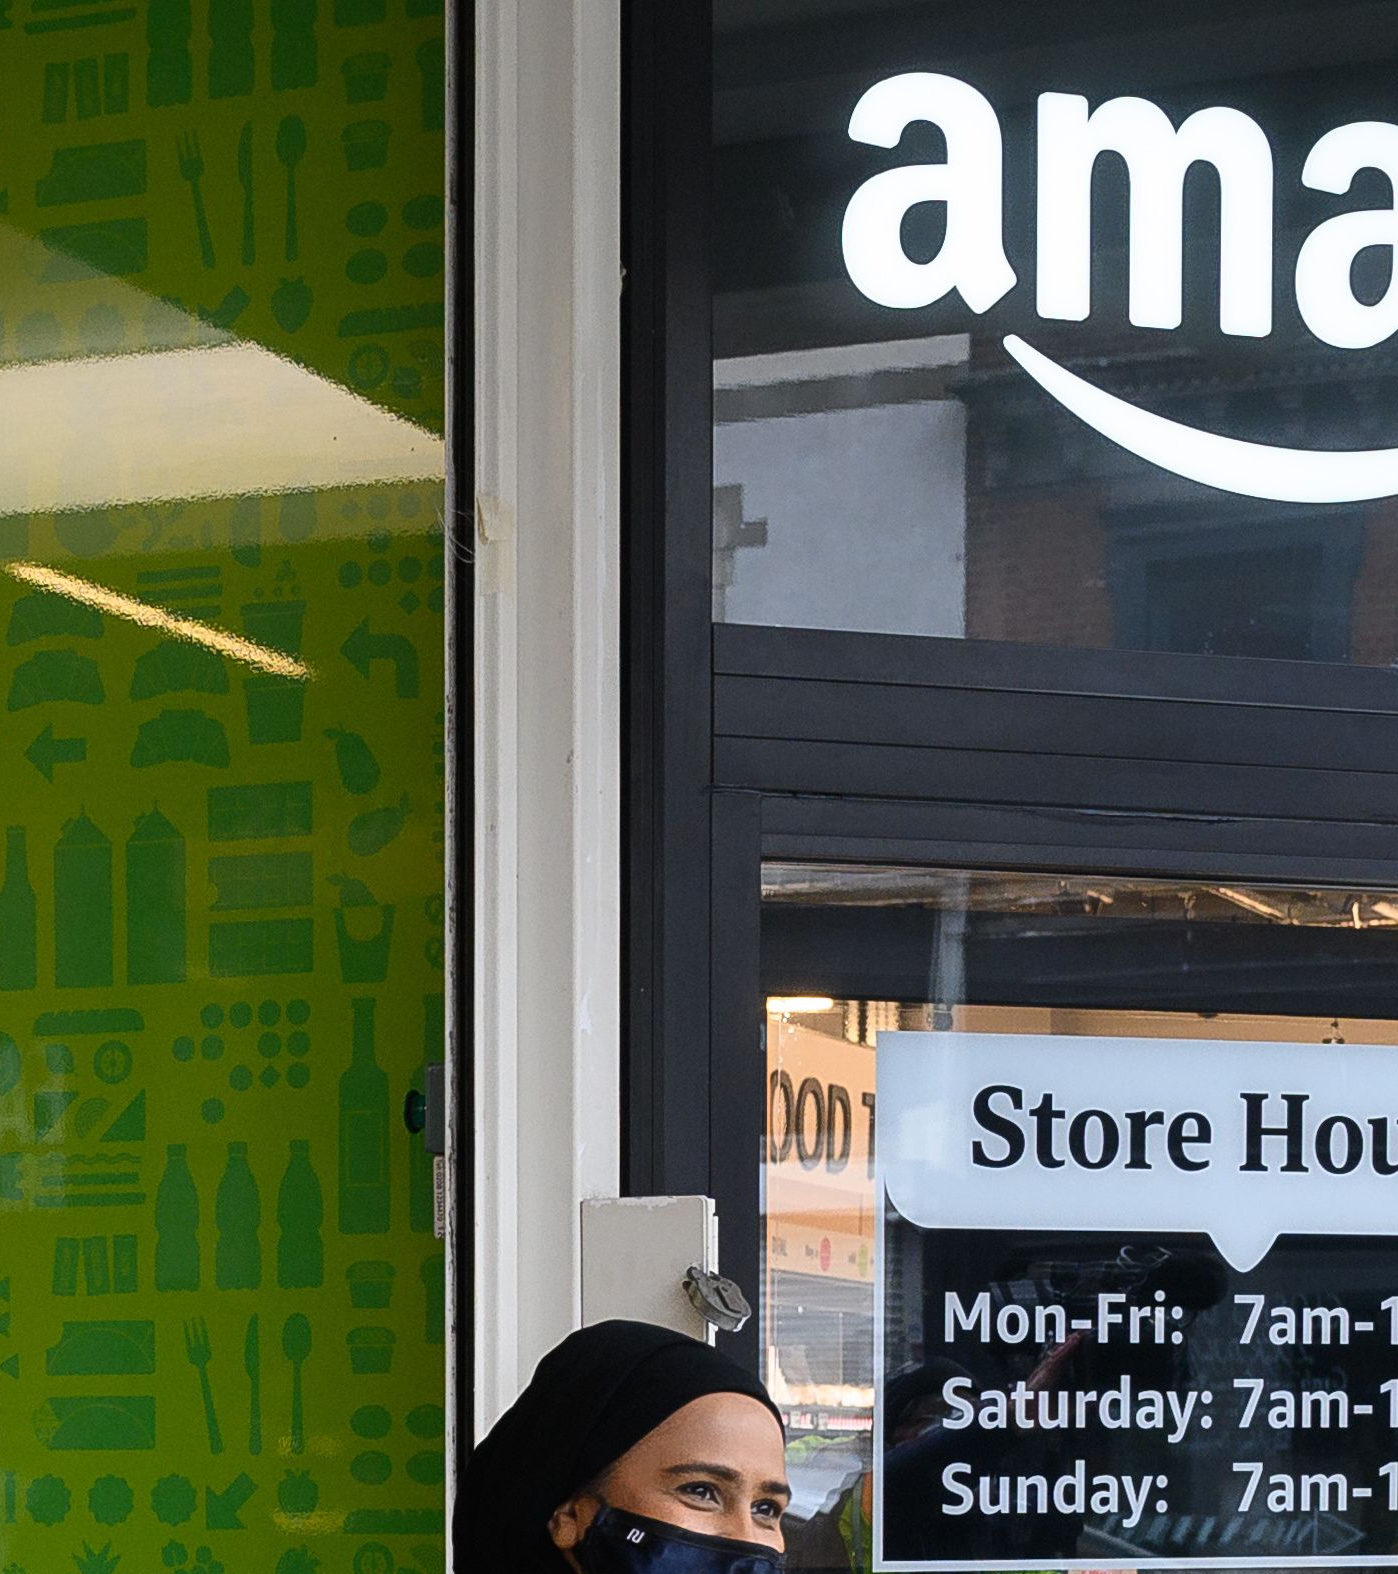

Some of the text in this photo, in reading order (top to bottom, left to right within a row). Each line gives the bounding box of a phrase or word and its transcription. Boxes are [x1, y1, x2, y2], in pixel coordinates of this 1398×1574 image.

[971, 1084, 1212, 1172] Store
[944, 1290, 1183, 1345] Mon-Fri:
[941, 1374, 1213, 1443] Saturday:
[941, 1459, 1168, 1528] Sunday:
